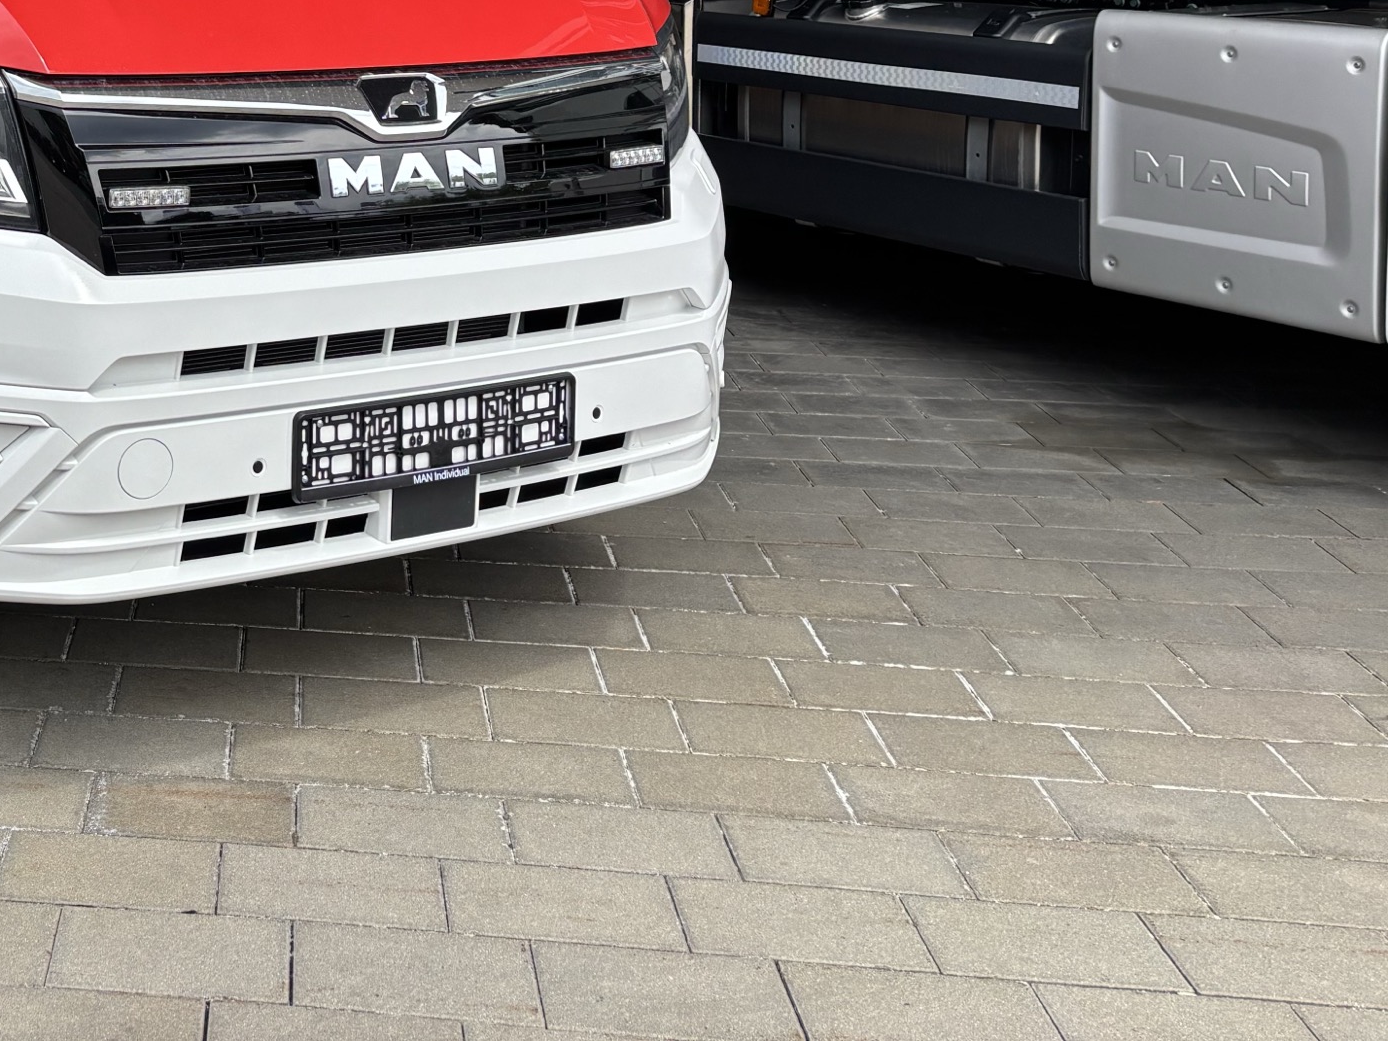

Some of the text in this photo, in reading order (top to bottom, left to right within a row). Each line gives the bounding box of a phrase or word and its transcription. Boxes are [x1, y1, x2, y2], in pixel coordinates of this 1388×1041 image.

[326, 146, 498, 199] MAN
[1133, 149, 1309, 207] MAN
[413, 466, 471, 485] MAN Individual
